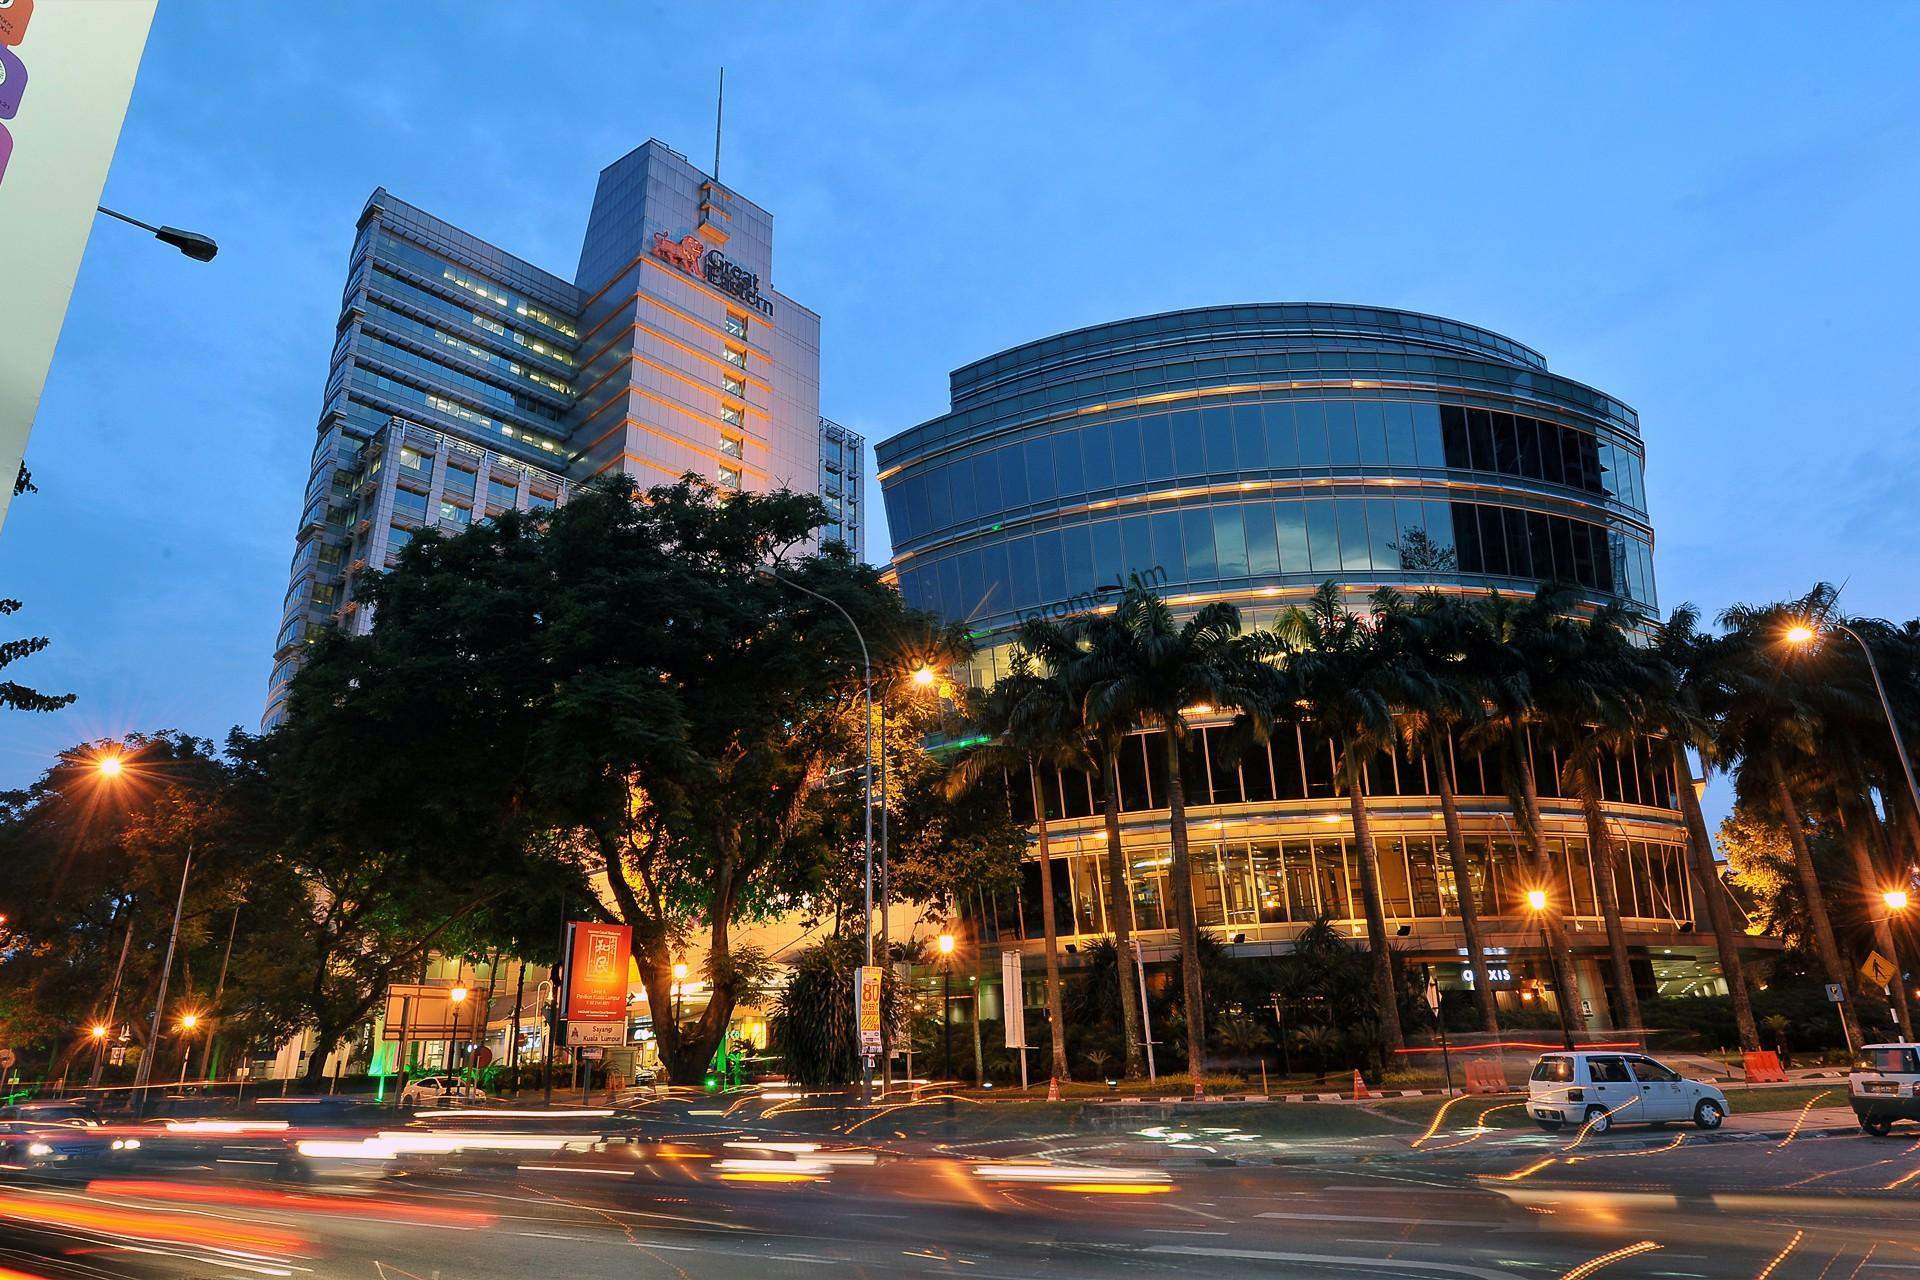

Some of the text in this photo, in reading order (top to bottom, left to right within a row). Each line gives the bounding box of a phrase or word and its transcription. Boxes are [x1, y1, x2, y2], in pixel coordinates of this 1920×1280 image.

[704, 249, 759, 290] Great
[707, 268, 773, 316] Eastern
[583, 1033, 621, 1043] Kuala Lumpur
